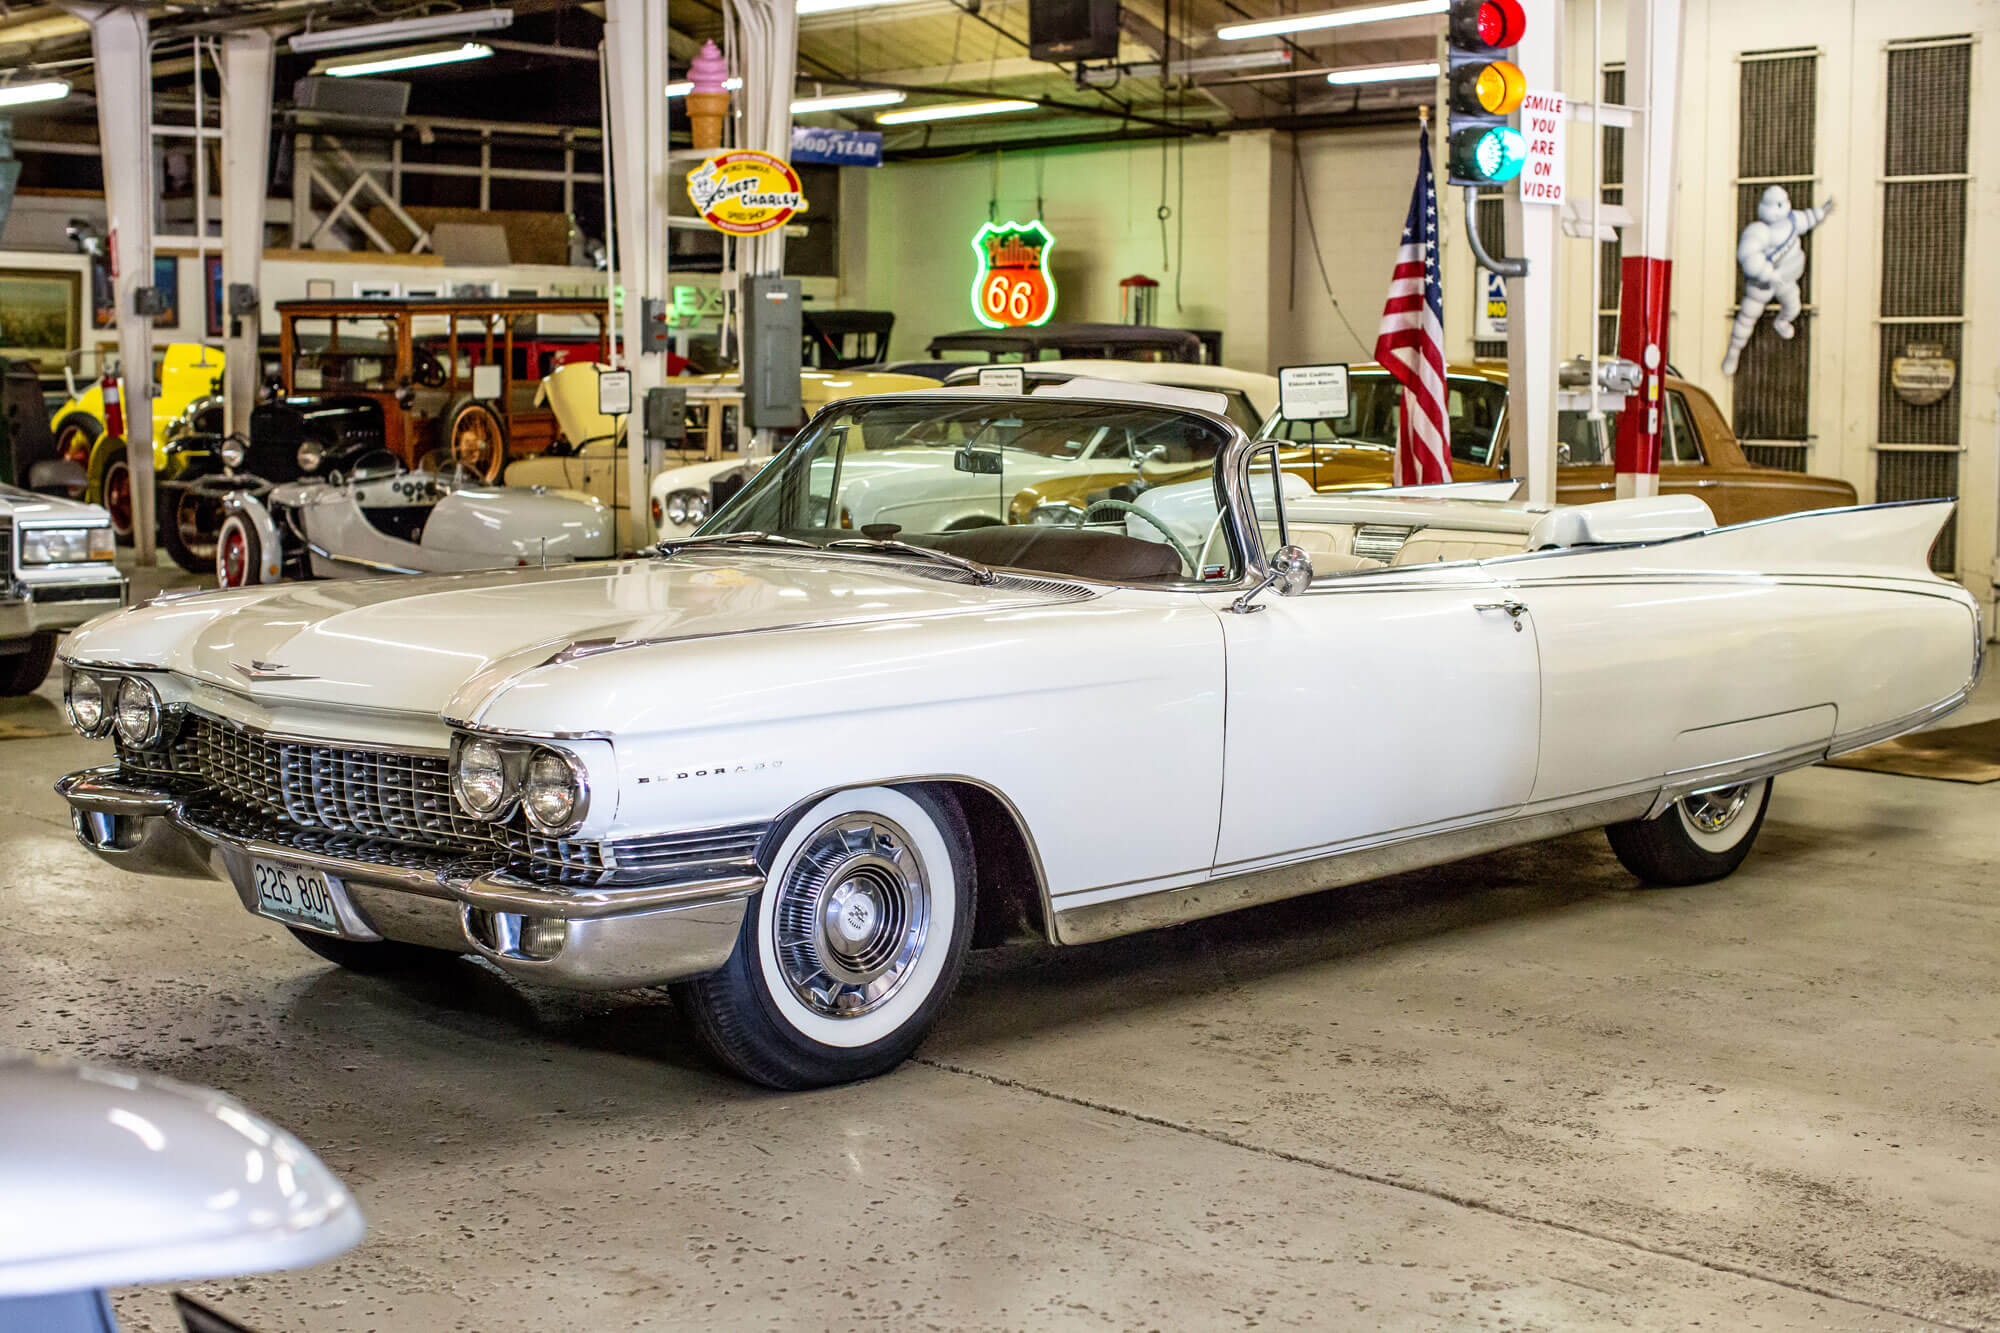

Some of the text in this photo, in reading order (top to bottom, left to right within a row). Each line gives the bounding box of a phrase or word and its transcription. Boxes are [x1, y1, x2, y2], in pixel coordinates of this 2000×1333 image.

[1524, 95, 1563, 113] SMILE
[1532, 117, 1556, 134] YOU
[1531, 139, 1555, 155] ARE
[1534, 161, 1552, 177] ON
[1524, 181, 1561, 199] VIDEO
[741, 193, 799, 208] CHARLEY
[985, 235, 1041, 270] Phillips
[988, 276, 1031, 319] 66
[638, 760, 783, 784] ELDORADO
[256, 864, 292, 904] 226
